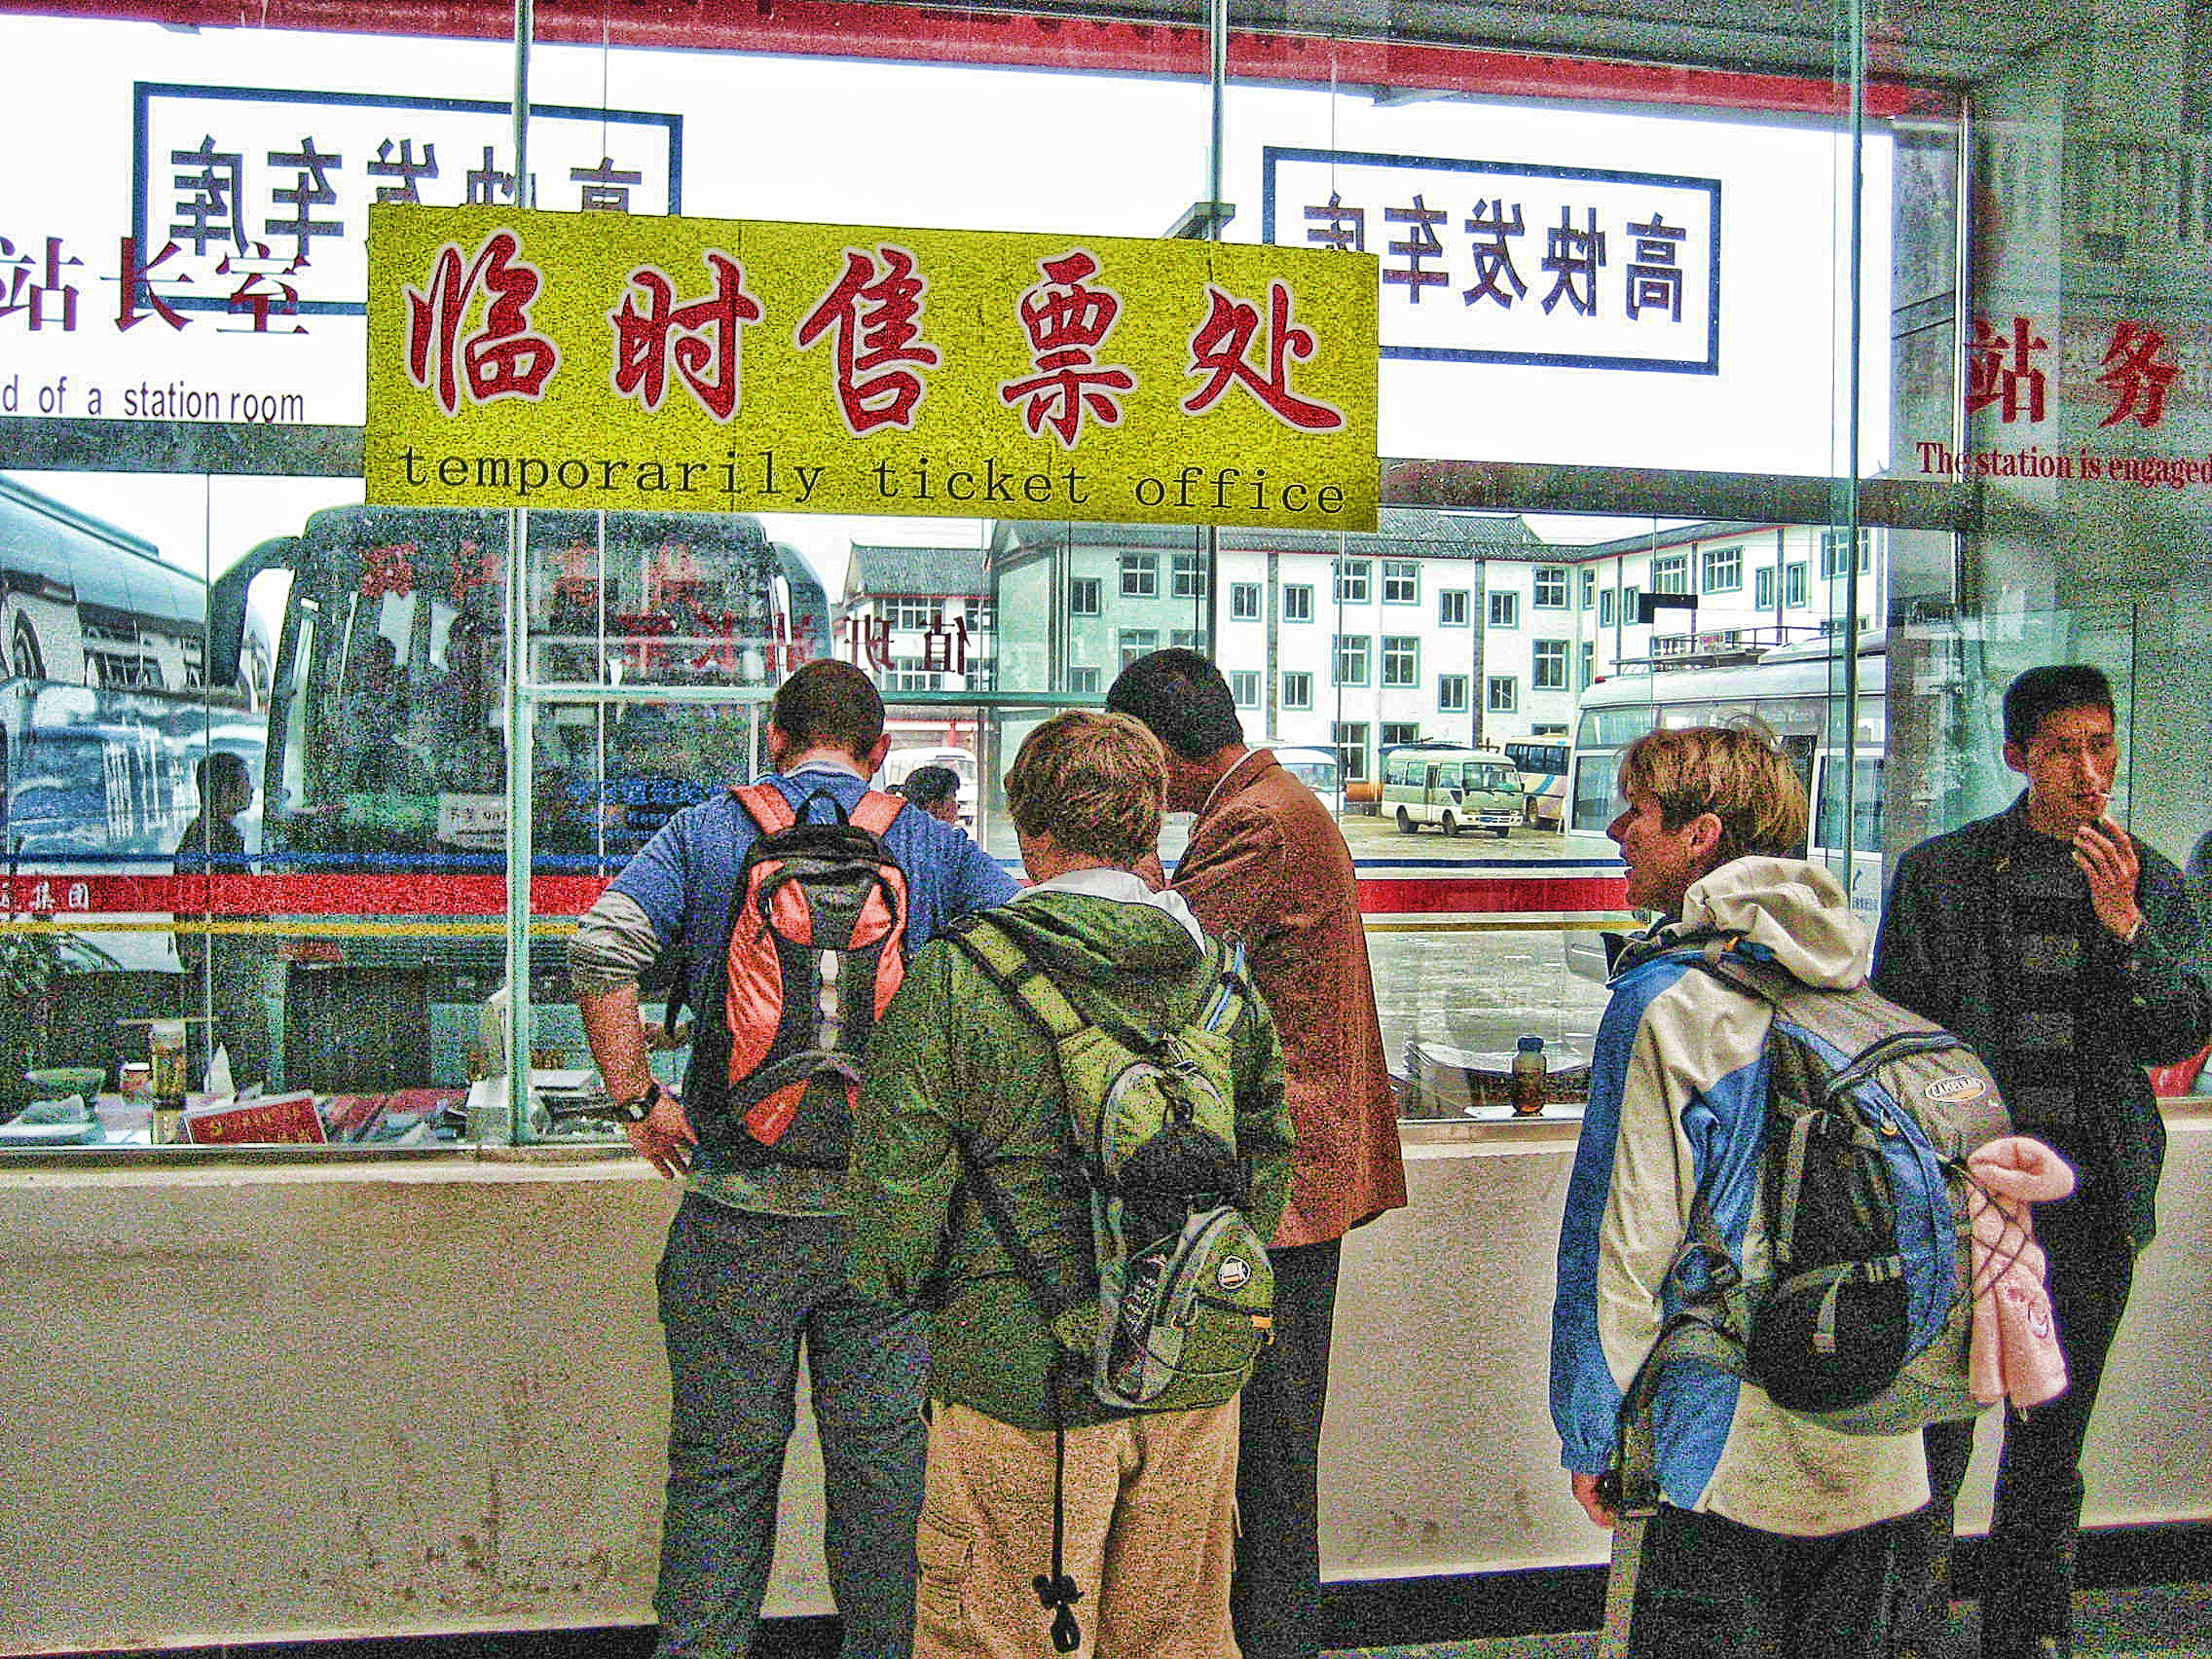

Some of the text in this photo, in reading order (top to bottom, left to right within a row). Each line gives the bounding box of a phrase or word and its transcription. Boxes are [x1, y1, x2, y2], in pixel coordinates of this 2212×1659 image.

[0, 236, 312, 335] 站长室
[408, 230, 1345, 448] 临时售票处
[1964, 315, 2185, 430] 站务
[38, 376, 68, 415] of
[87, 387, 102, 416] a
[124, 381, 220, 419] station
[230, 391, 305, 422] room
[401, 445, 1346, 514] temporarily ticket office
[1916, 441, 2212, 489] The station is engaged
